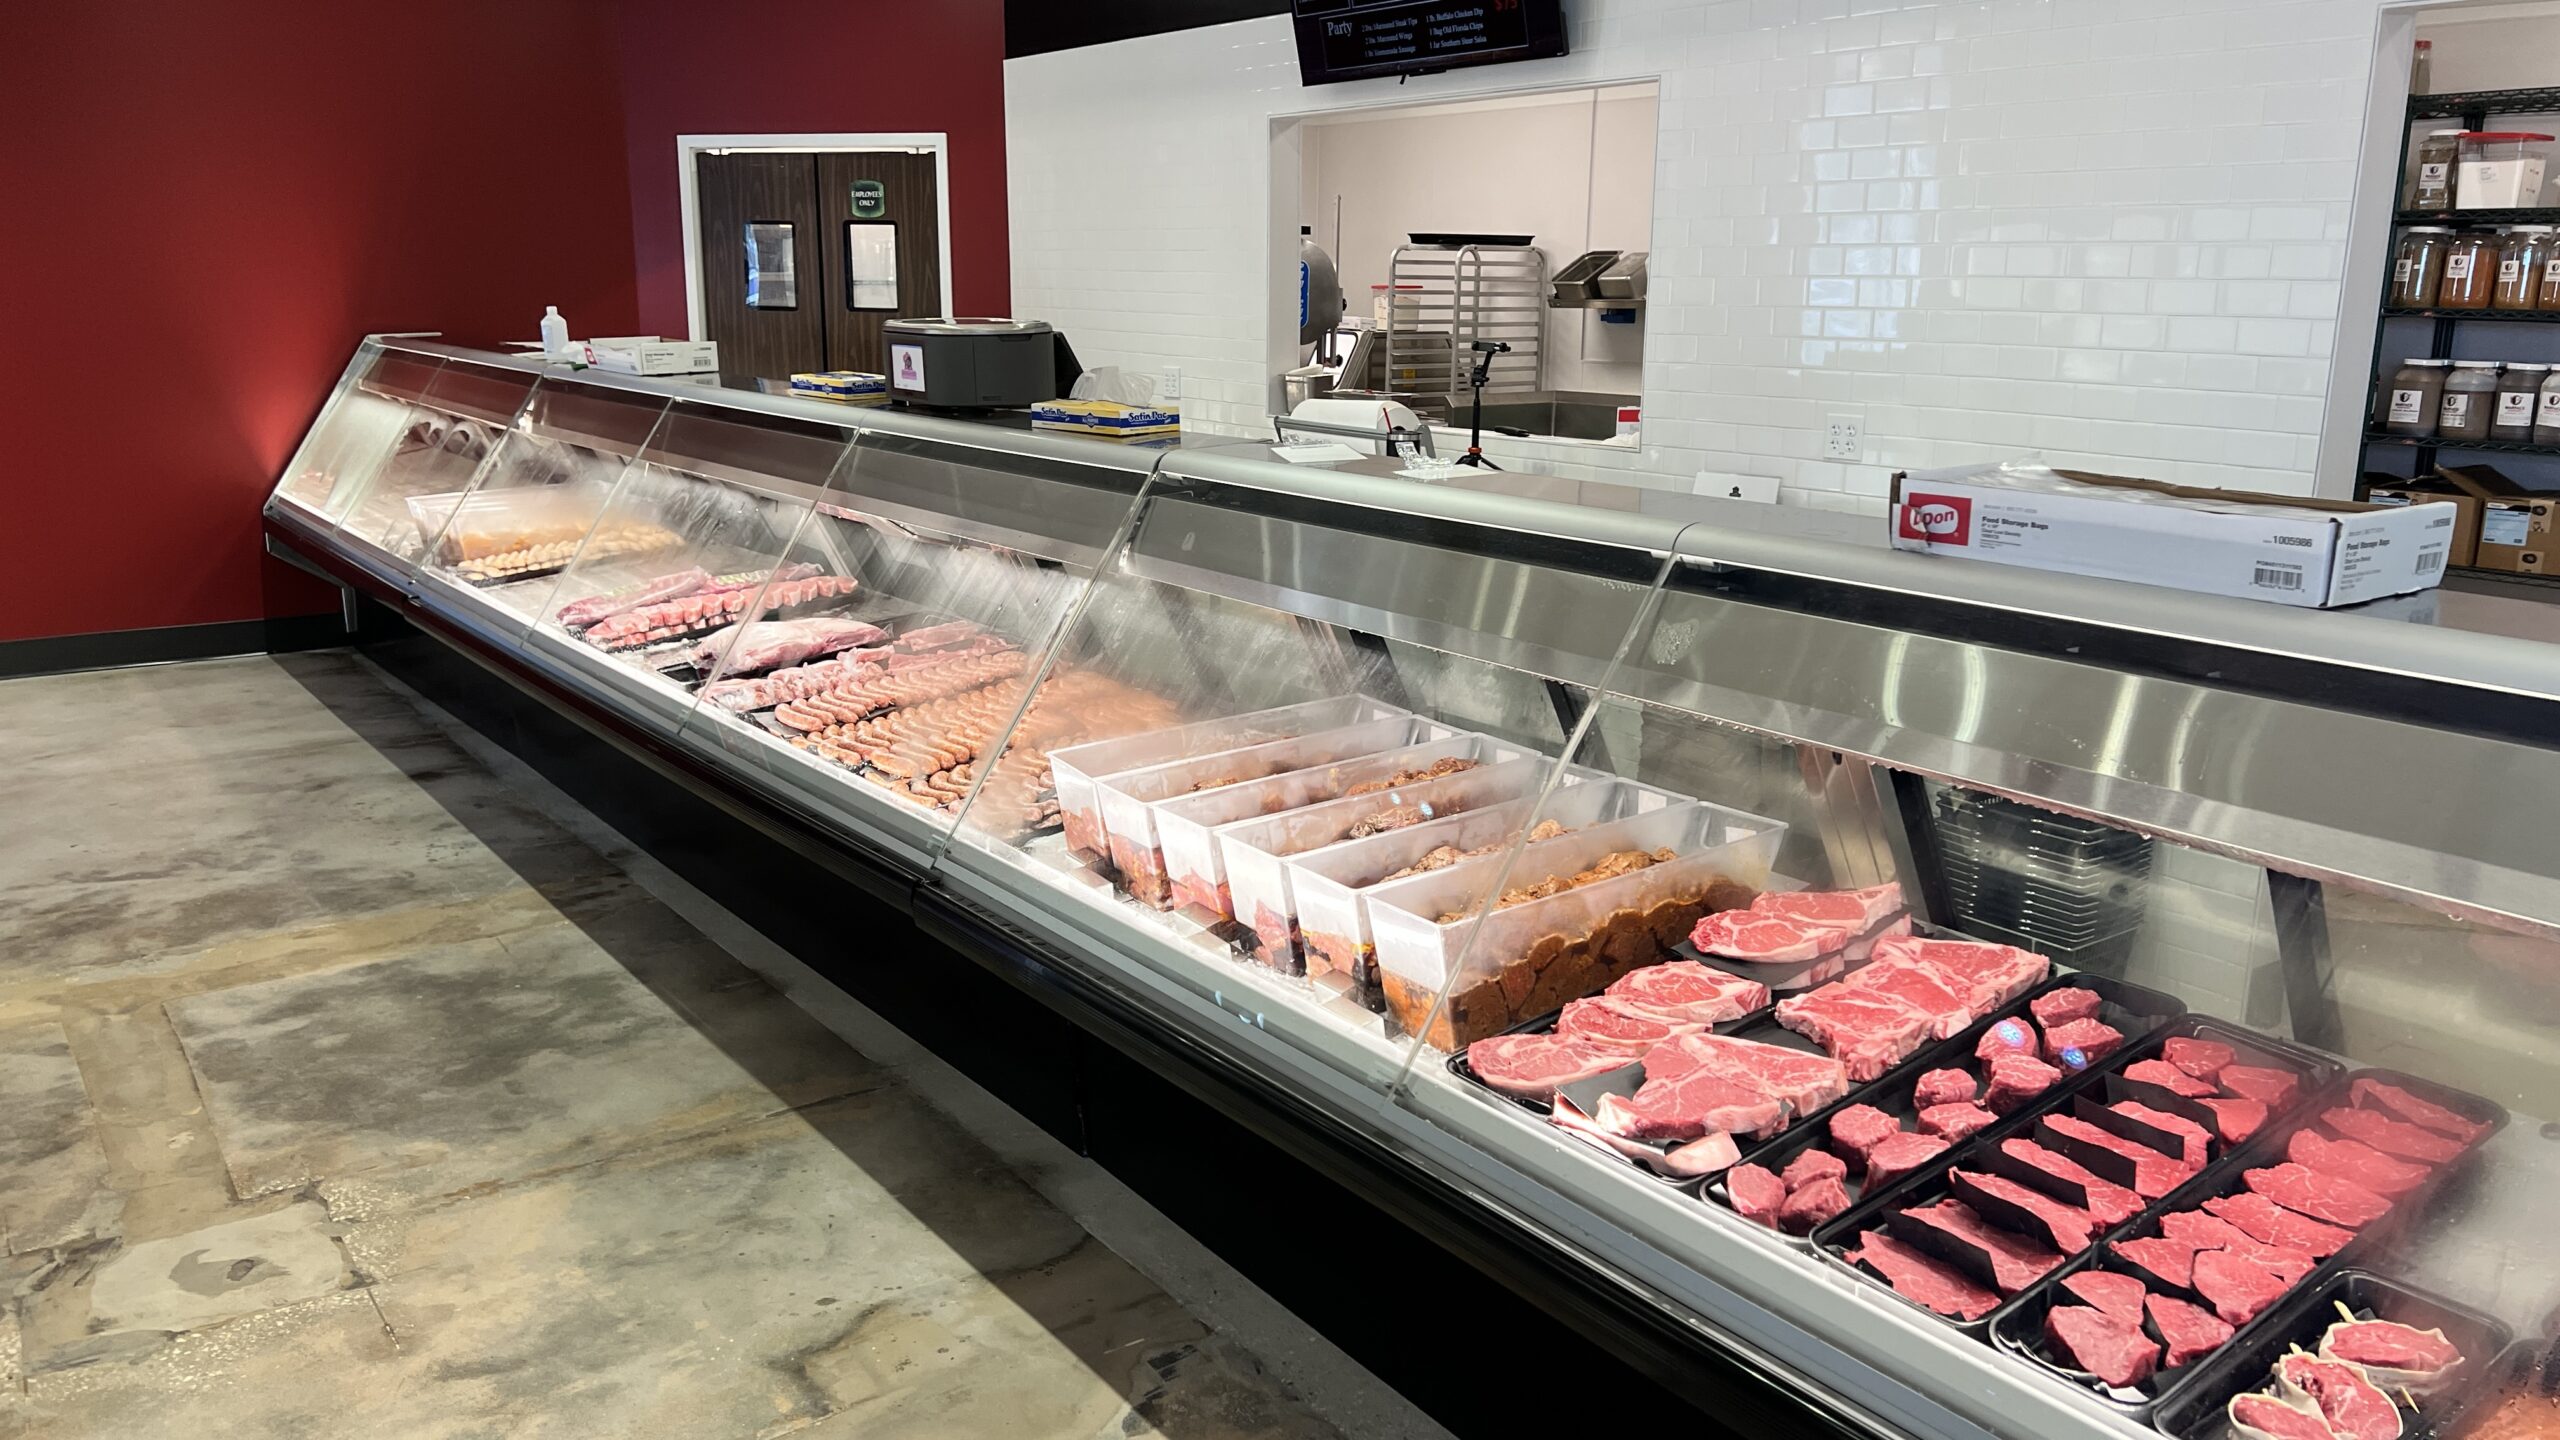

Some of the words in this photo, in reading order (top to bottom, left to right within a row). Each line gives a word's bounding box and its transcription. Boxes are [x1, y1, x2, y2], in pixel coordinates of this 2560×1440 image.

[1436, 12, 1454, 21] Buffalo
[1454, 9, 1473, 19] Chicken
[1473, 8, 1484, 17] Dip
[1327, 21, 1353, 37] Party
[1443, 24, 1452, 34] Old
[1452, 23, 1469, 33] Florida
[1469, 22, 1484, 31] Chips
[1399, 32, 1413, 40] Wings
[1440, 38, 1461, 48] Southern
[1474, 35, 1487, 43] Salsa
[851, 190, 882, 198] EMPLOYEES
[859, 199, 875, 207] ONLY
[852, 382, 873, 391] Satin
[1041, 407, 1056, 417] Satin
[1056, 409, 1067, 418] Pac
[1128, 411, 1151, 422] Satin
[1151, 410, 1167, 420] Pac
[1982, 516, 1999, 524] Food
[2001, 518, 2029, 528] Storage
[2031, 521, 2049, 530] Bags
[2273, 535, 2313, 547] 1005986
